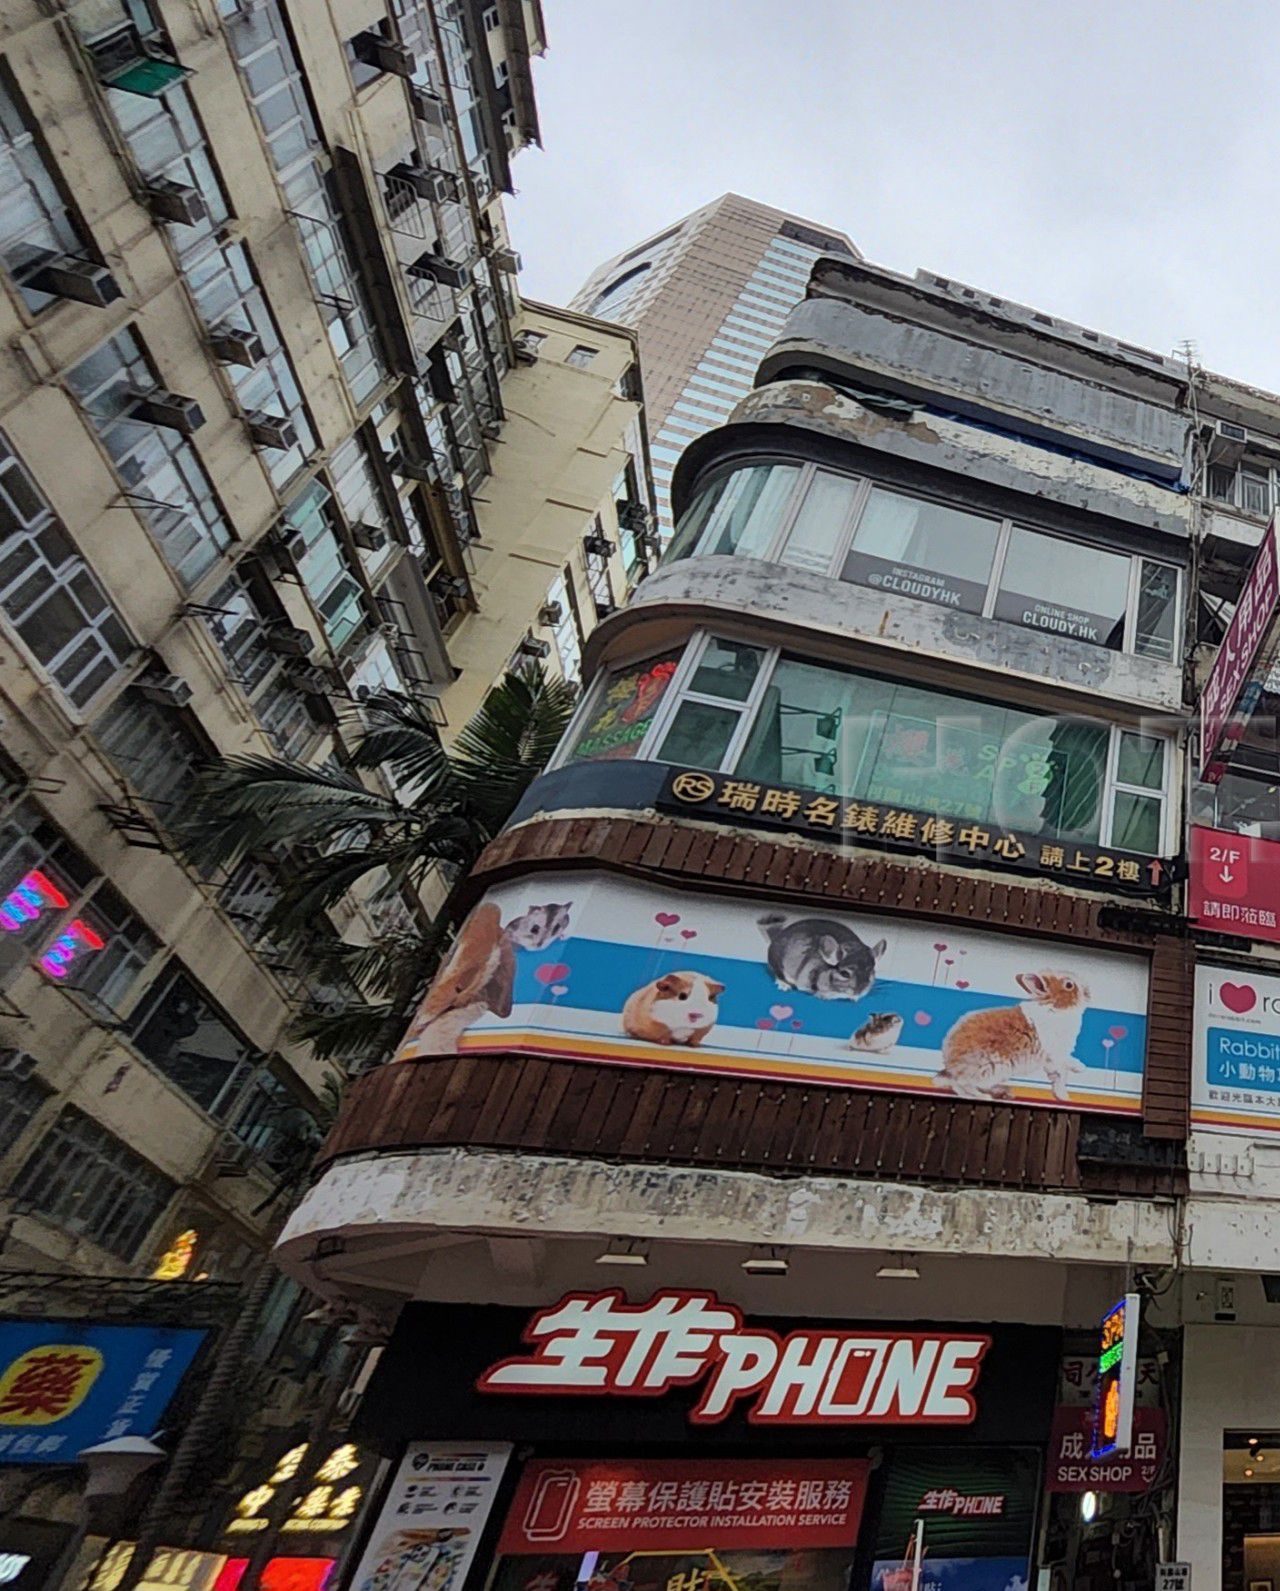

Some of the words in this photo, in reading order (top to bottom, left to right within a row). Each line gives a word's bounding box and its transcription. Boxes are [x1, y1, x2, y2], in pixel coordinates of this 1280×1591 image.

[868, 572, 962, 606] @CLOUDYHK
[891, 567, 946, 588] INSTAGRAM
[1022, 610, 1098, 641] CLOUDY.HK
[1034, 603, 1065, 619] ONLINE
[1066, 611, 1090, 624] SHOP
[1240, 583, 1274, 671] SHOP
[717, 779, 1027, 862] 瑞時名錶維修中心
[1039, 843, 1141, 884] 請上2樓
[1209, 846, 1241, 865] 2/F
[1203, 901, 1277, 929] 請即蒞臨
[1219, 1036, 1280, 1060] Rabbit
[699, 1334, 985, 1416] PHONE
[1057, 1466, 1087, 1482] SEX
[1089, 1467, 1132, 1482] SHOP
[584, 1480, 853, 1513] 螢幕保護貼安裝服務
[953, 1496, 1004, 1514] PHONE
[577, 1516, 631, 1529] SCREEN
[632, 1516, 708, 1528] PROTECTOR
[710, 1515, 797, 1528] INSTALLATION
[798, 1514, 847, 1526] SERVICE
